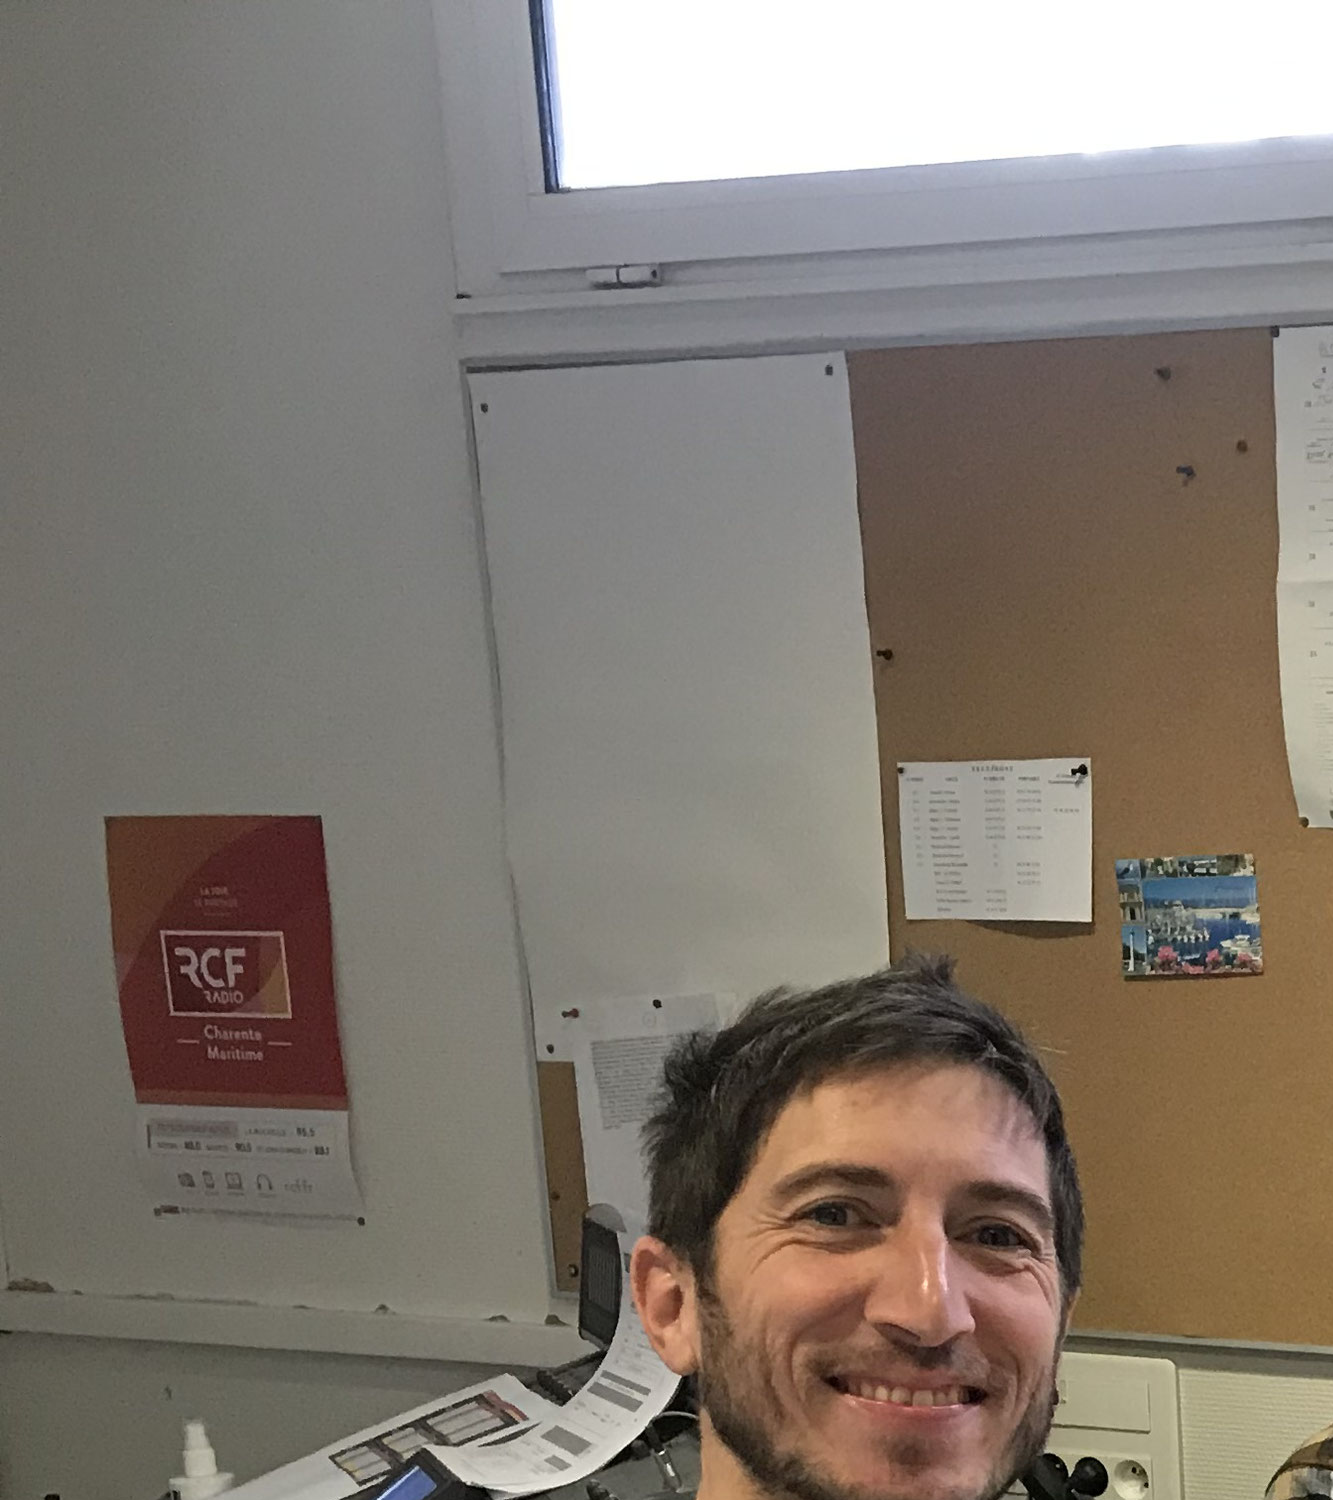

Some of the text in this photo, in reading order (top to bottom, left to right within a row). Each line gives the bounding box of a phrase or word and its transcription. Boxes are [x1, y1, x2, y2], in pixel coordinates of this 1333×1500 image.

[174, 947, 246, 988] RCF
[203, 990, 244, 1004] RADIO
[204, 1025, 262, 1041] Charente
[207, 1046, 264, 1061] Maritime
